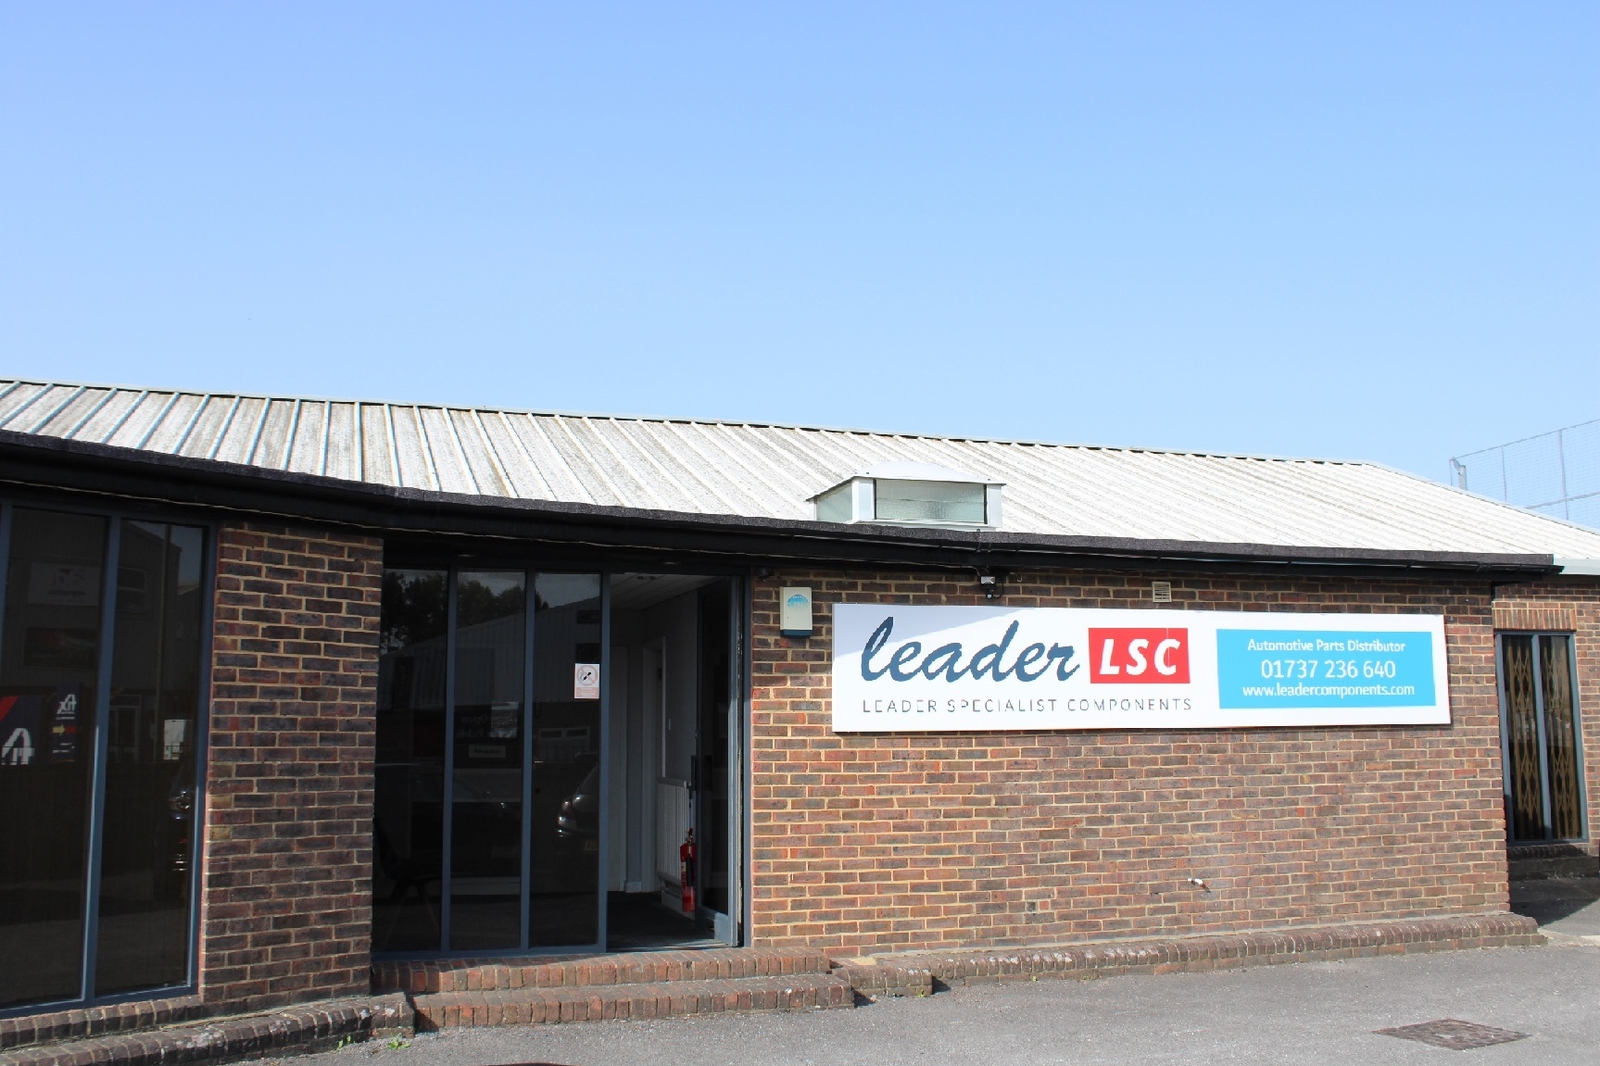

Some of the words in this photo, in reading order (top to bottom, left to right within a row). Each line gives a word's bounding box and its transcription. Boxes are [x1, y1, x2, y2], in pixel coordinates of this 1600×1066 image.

[861, 616, 1079, 682] leader
[1247, 638, 1314, 651] Automotive
[1316, 639, 1345, 652] Parts
[1347, 640, 1406, 652] Distributor
[1099, 638, 1181, 675] LSC
[1261, 659, 1318, 679] 01737
[1324, 660, 1359, 679] 236
[1363, 660, 1396, 679] 640
[1242, 682, 1415, 699] www.leadercomponents.com
[862, 699, 938, 713] LEADER
[947, 699, 1057, 713] SPECIALIST
[1067, 698, 1192, 712] COMPONENTS
